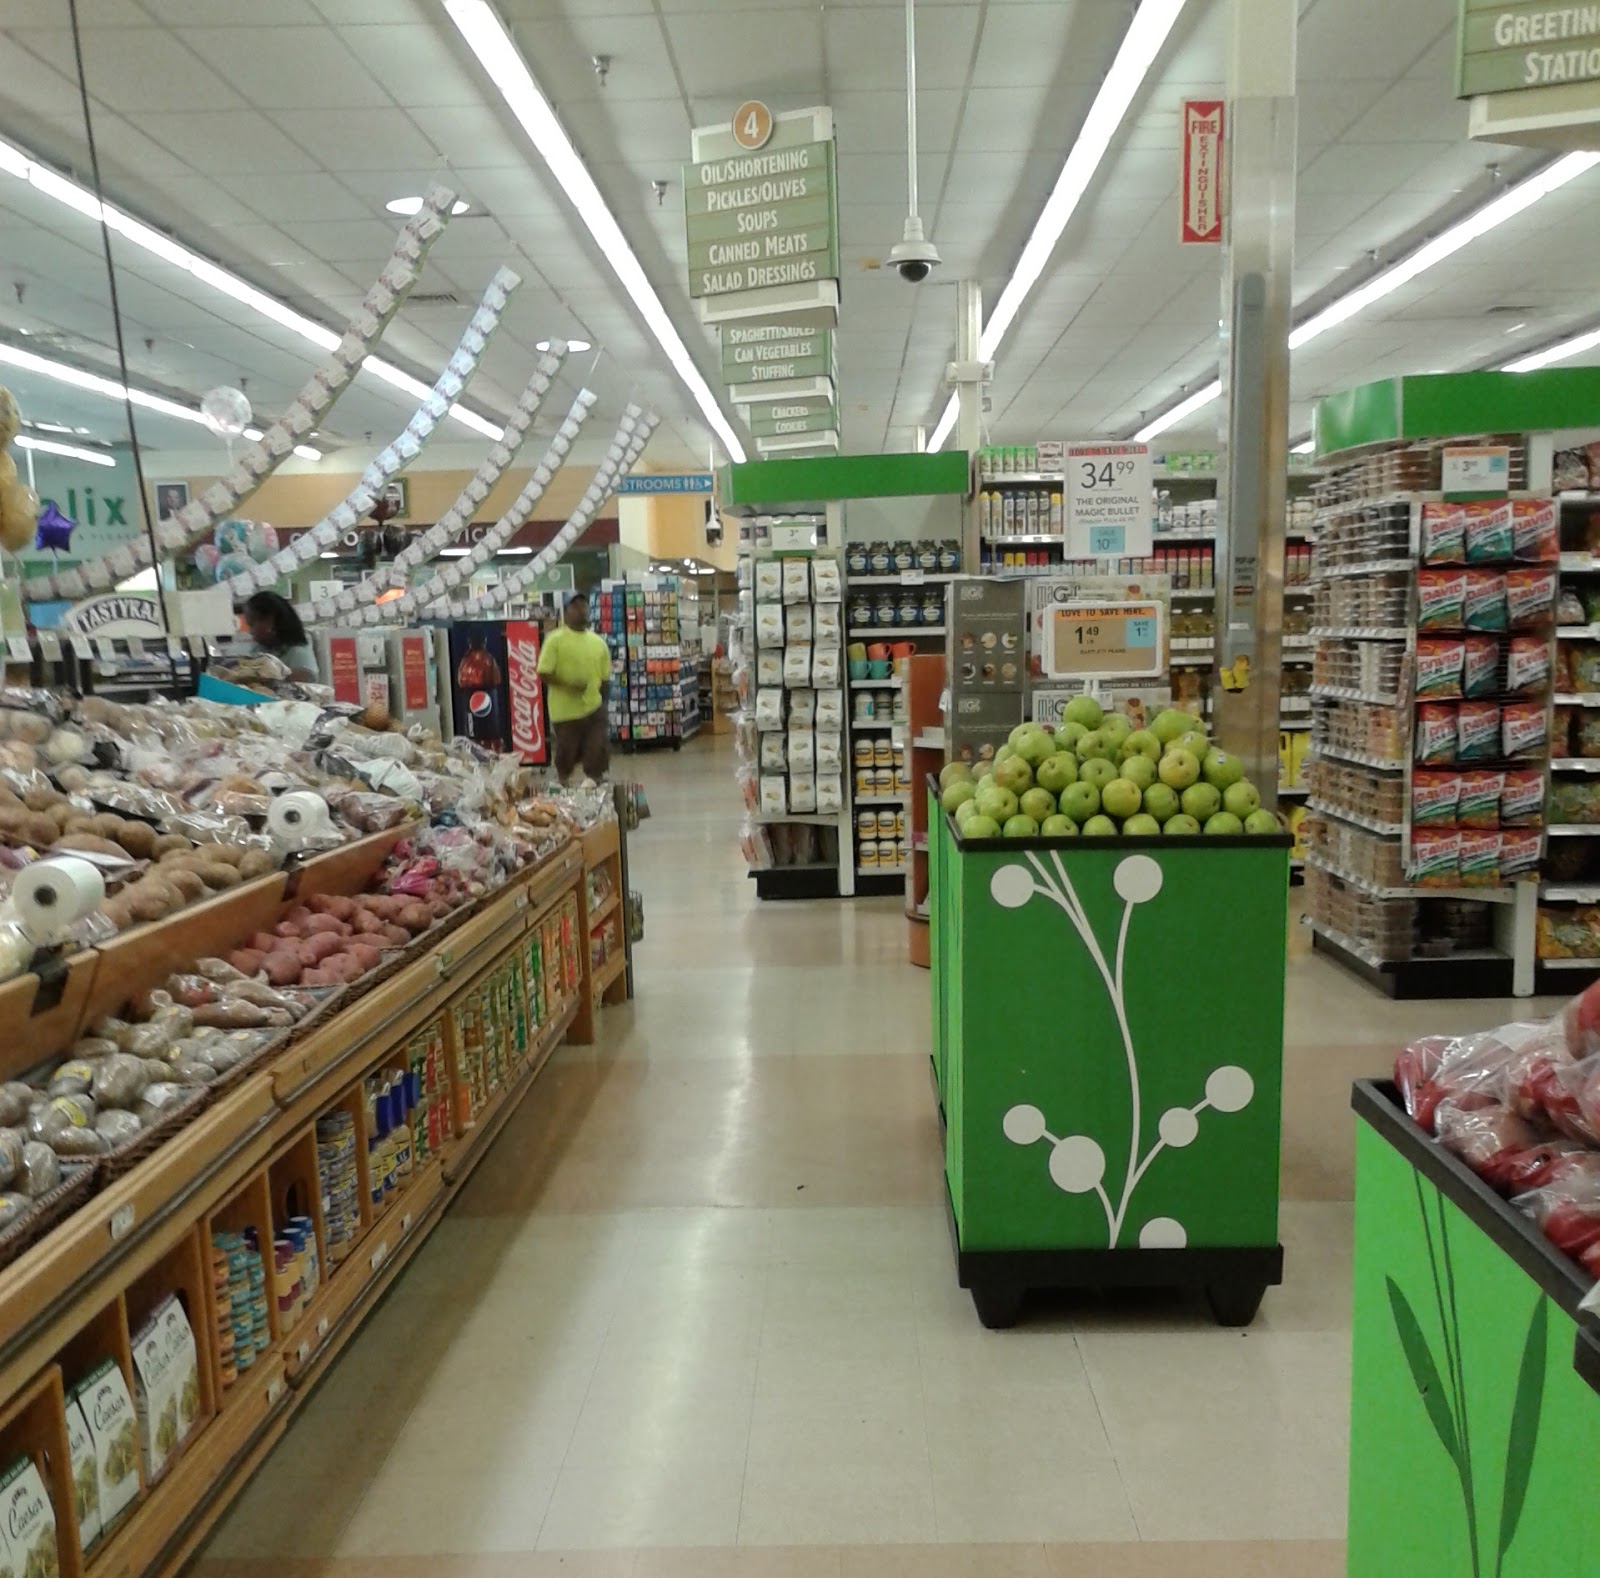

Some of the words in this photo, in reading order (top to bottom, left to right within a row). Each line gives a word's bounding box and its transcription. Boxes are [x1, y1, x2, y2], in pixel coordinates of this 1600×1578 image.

[1495, 6, 1600, 45] GREETIN
[743, 111, 760, 139] 4
[1192, 120, 1217, 134] FIRE
[707, 178, 807, 211] PICKLES/OLIVES
[737, 210, 778, 233] SOUPS
[709, 242, 760, 265] CANNED
[766, 234, 807, 257] MEATS
[703, 272, 742, 293] SALAD
[748, 261, 816, 287] DRESSINGS
[735, 348, 754, 363] CAN
[756, 342, 811, 360] VEGETABLES
[752, 364, 795, 380] STUFFING
[66, 487, 127, 527] lix
[1075, 508, 1105, 517] MAGIC
[1108, 506, 1140, 516] BULLET
[1076, 498, 1093, 506] THE
[1096, 496, 1139, 505] ORIGINAL
[320, 586, 330, 599] 3
[1061, 609, 1081, 617] LOVE
[1100, 608, 1119, 616] SAVE
